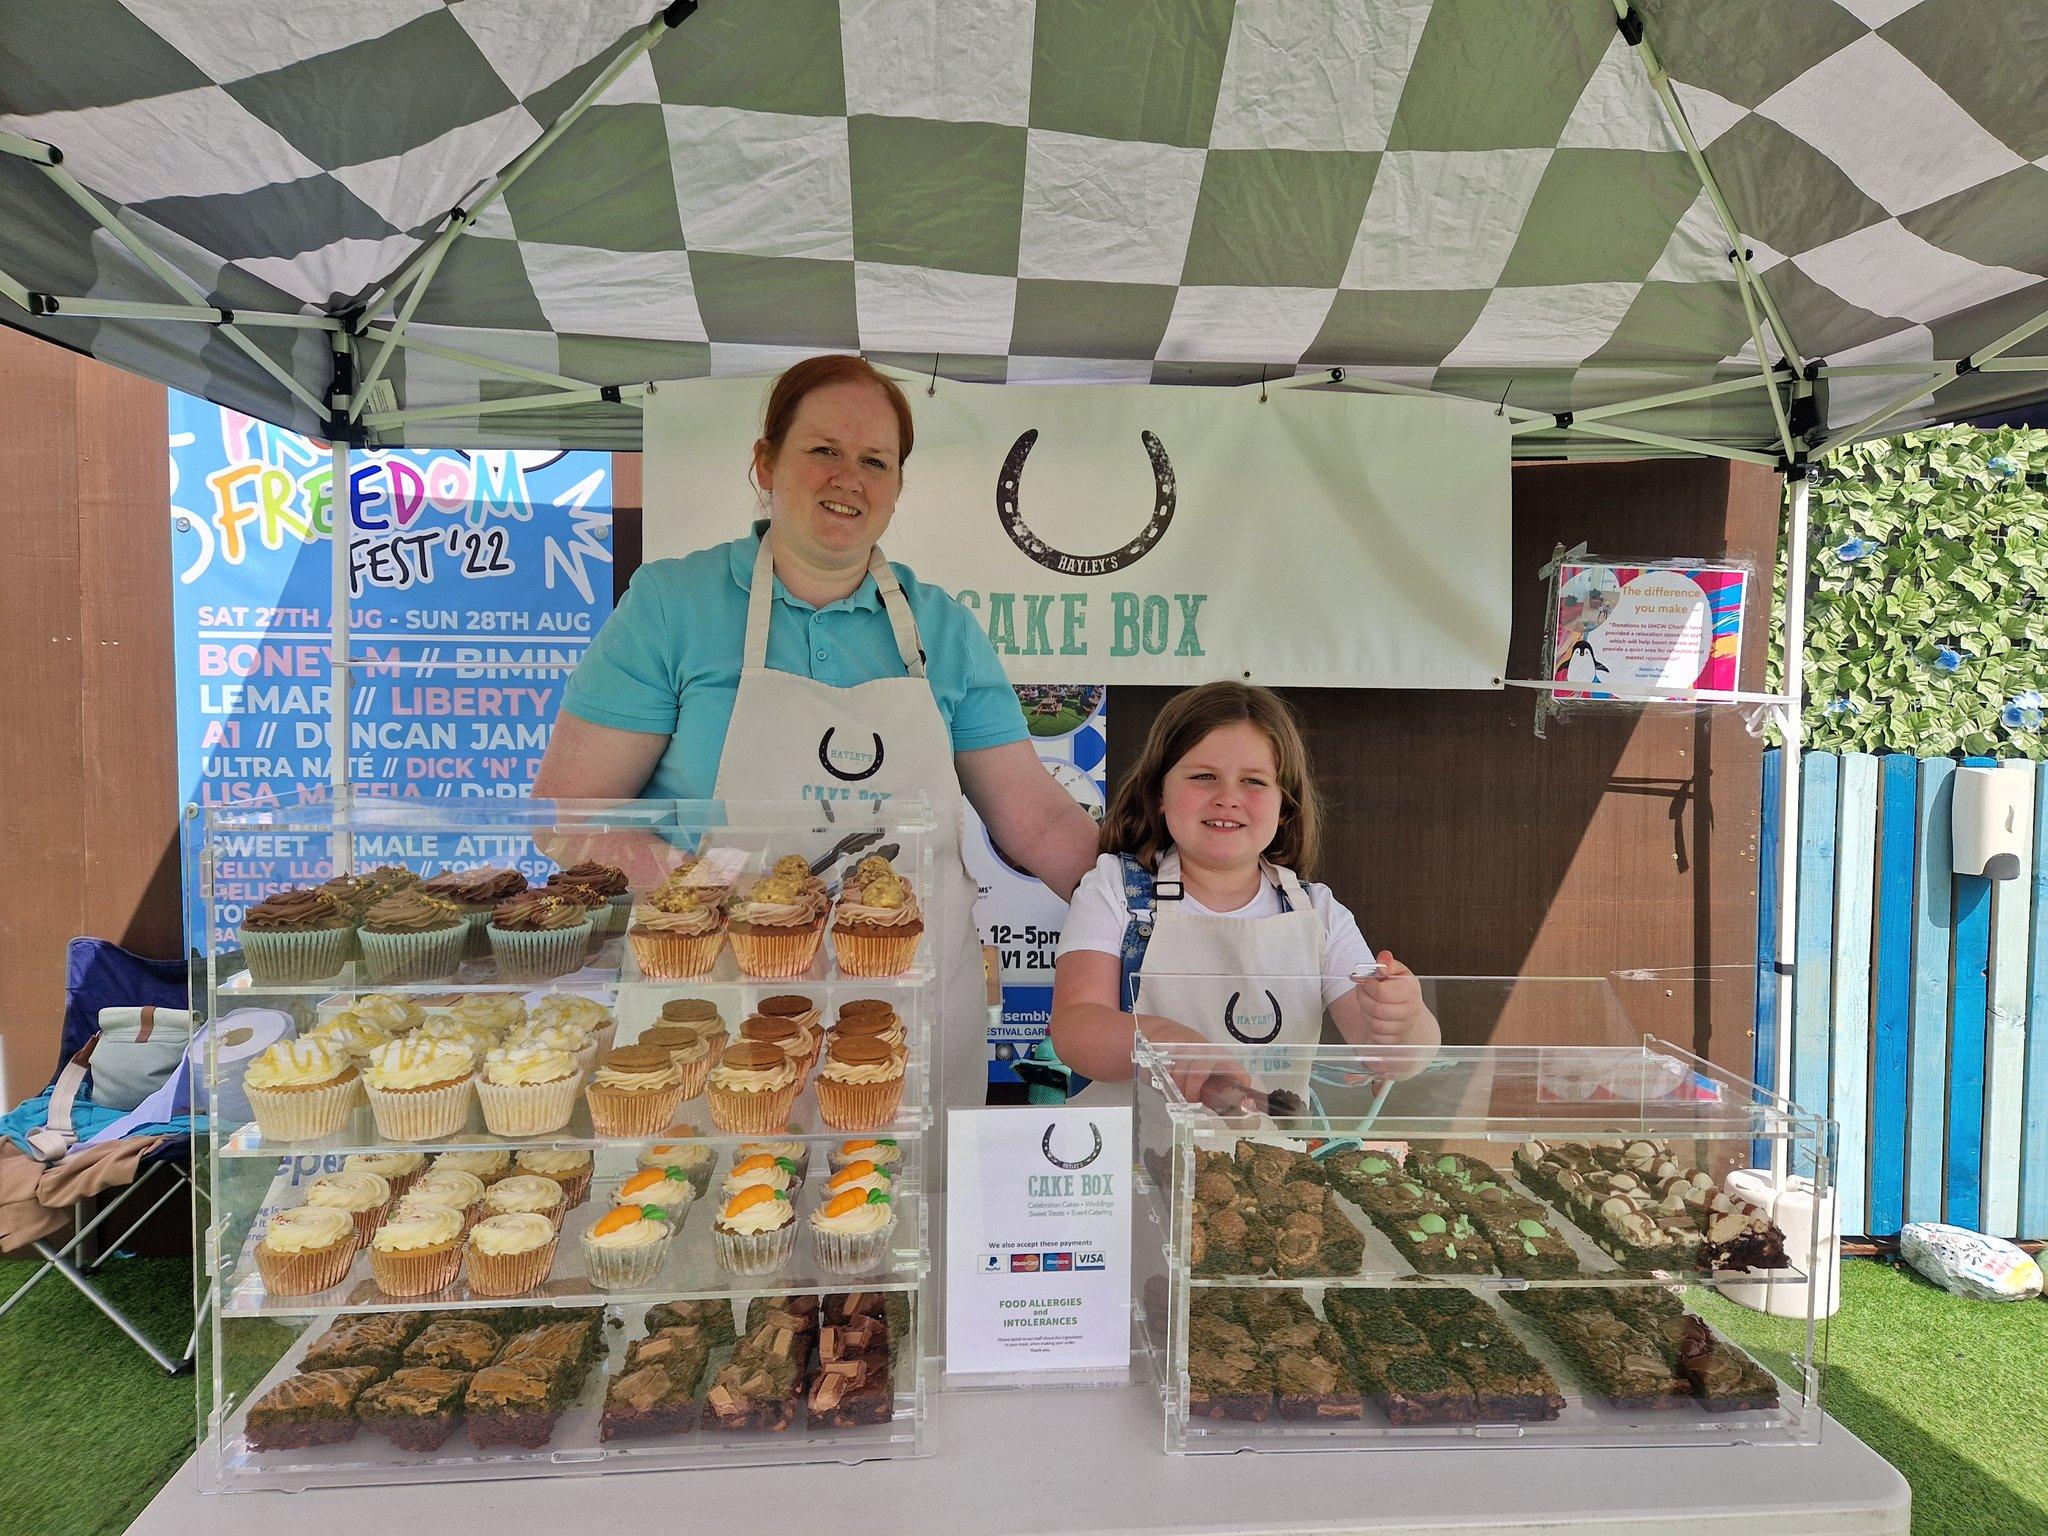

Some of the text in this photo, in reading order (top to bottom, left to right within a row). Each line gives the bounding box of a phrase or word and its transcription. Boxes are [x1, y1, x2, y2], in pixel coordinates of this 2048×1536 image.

[350, 530, 510, 593] FEST '22
[1057, 555, 1119, 574] HAYLEY'S
[1622, 586, 1702, 598] The difference
[198, 606, 249, 627] SAT
[255, 607, 319, 628] 27TH
[327, 608, 382, 629] UG
[405, 610, 458, 630] SUN
[466, 611, 529, 630] 28TH
[536, 612, 591, 632] AUG
[1635, 604, 1689, 616] you make
[1109, 591, 1208, 657] BOX
[366, 647, 400, 678] M
[456, 648, 587, 680] BIMIN
[391, 686, 552, 717] LIBERTY
[202, 720, 240, 749] A1
[472, 722, 555, 750] JAM
[202, 756, 295, 778] ULTRA
[406, 757, 475, 779] DICK
[202, 781, 280, 808] LISA
[1028, 1173, 1114, 1197] CAKE BOX
[1002, 1241, 1016, 1249] also
[1016, 1240, 1039, 1249] accept
[1040, 1240, 1059, 1248] these
[1059, 1239, 1093, 1248] payments
[1079, 1253, 1104, 1264] VISA
[999, 1297, 1082, 1309] FOOD ALLERGIES
[1033, 1308, 1048, 1316] and
[1003, 1316, 1078, 1328] INTOLERANCES
